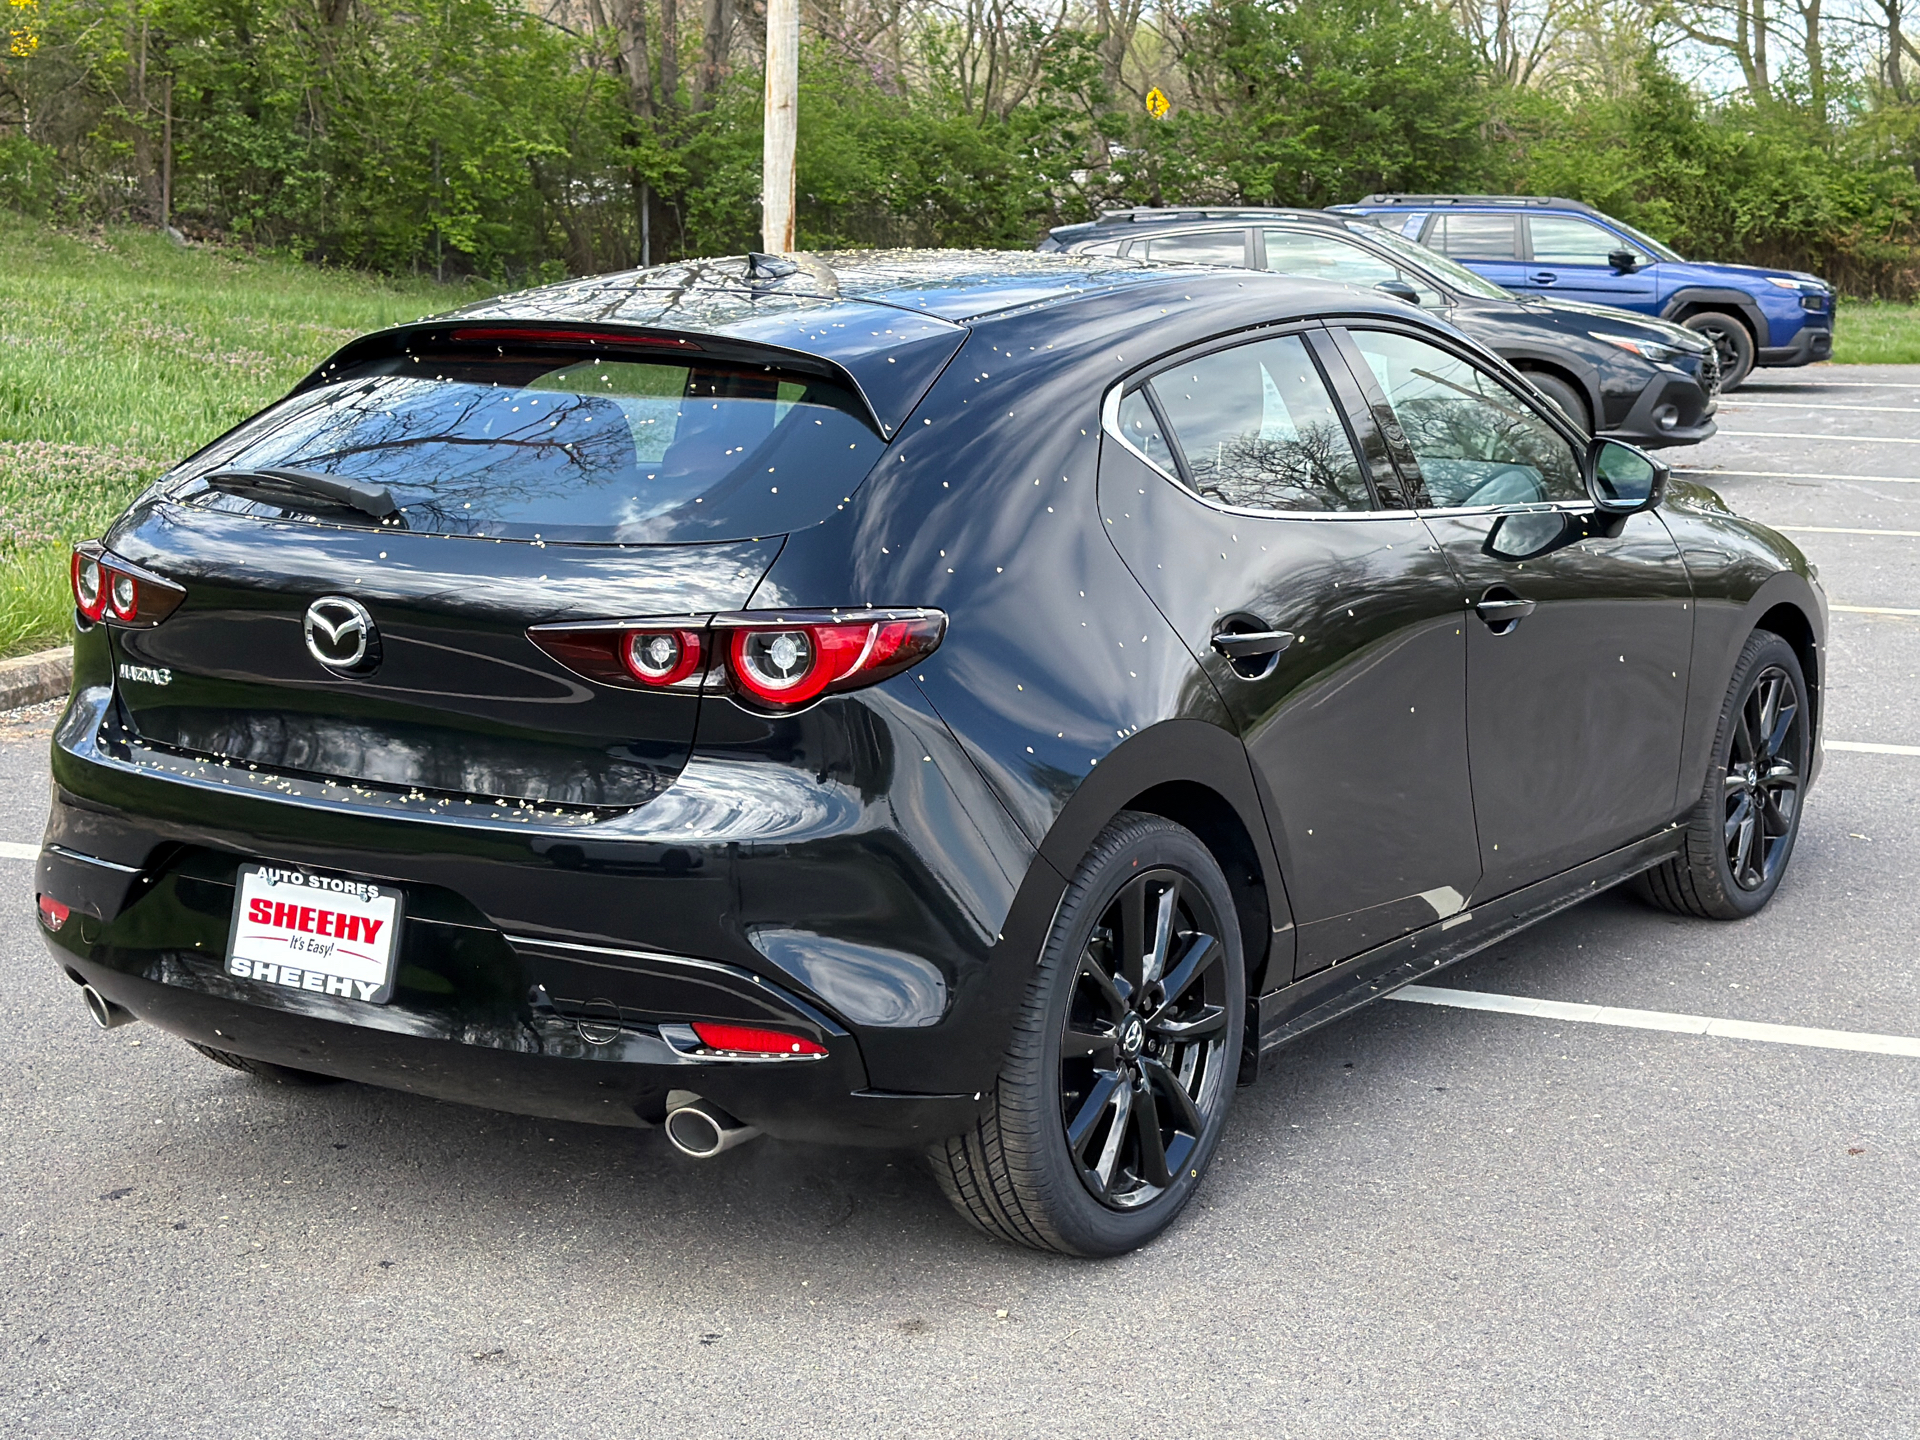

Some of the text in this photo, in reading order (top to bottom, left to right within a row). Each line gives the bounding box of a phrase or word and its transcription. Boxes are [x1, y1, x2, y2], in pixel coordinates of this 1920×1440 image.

[257, 866, 379, 898] AUTO STORES
[248, 897, 384, 945] SHEEHY
[289, 935, 335, 959] It's Easy!
[230, 957, 381, 1002] SHEEHY
